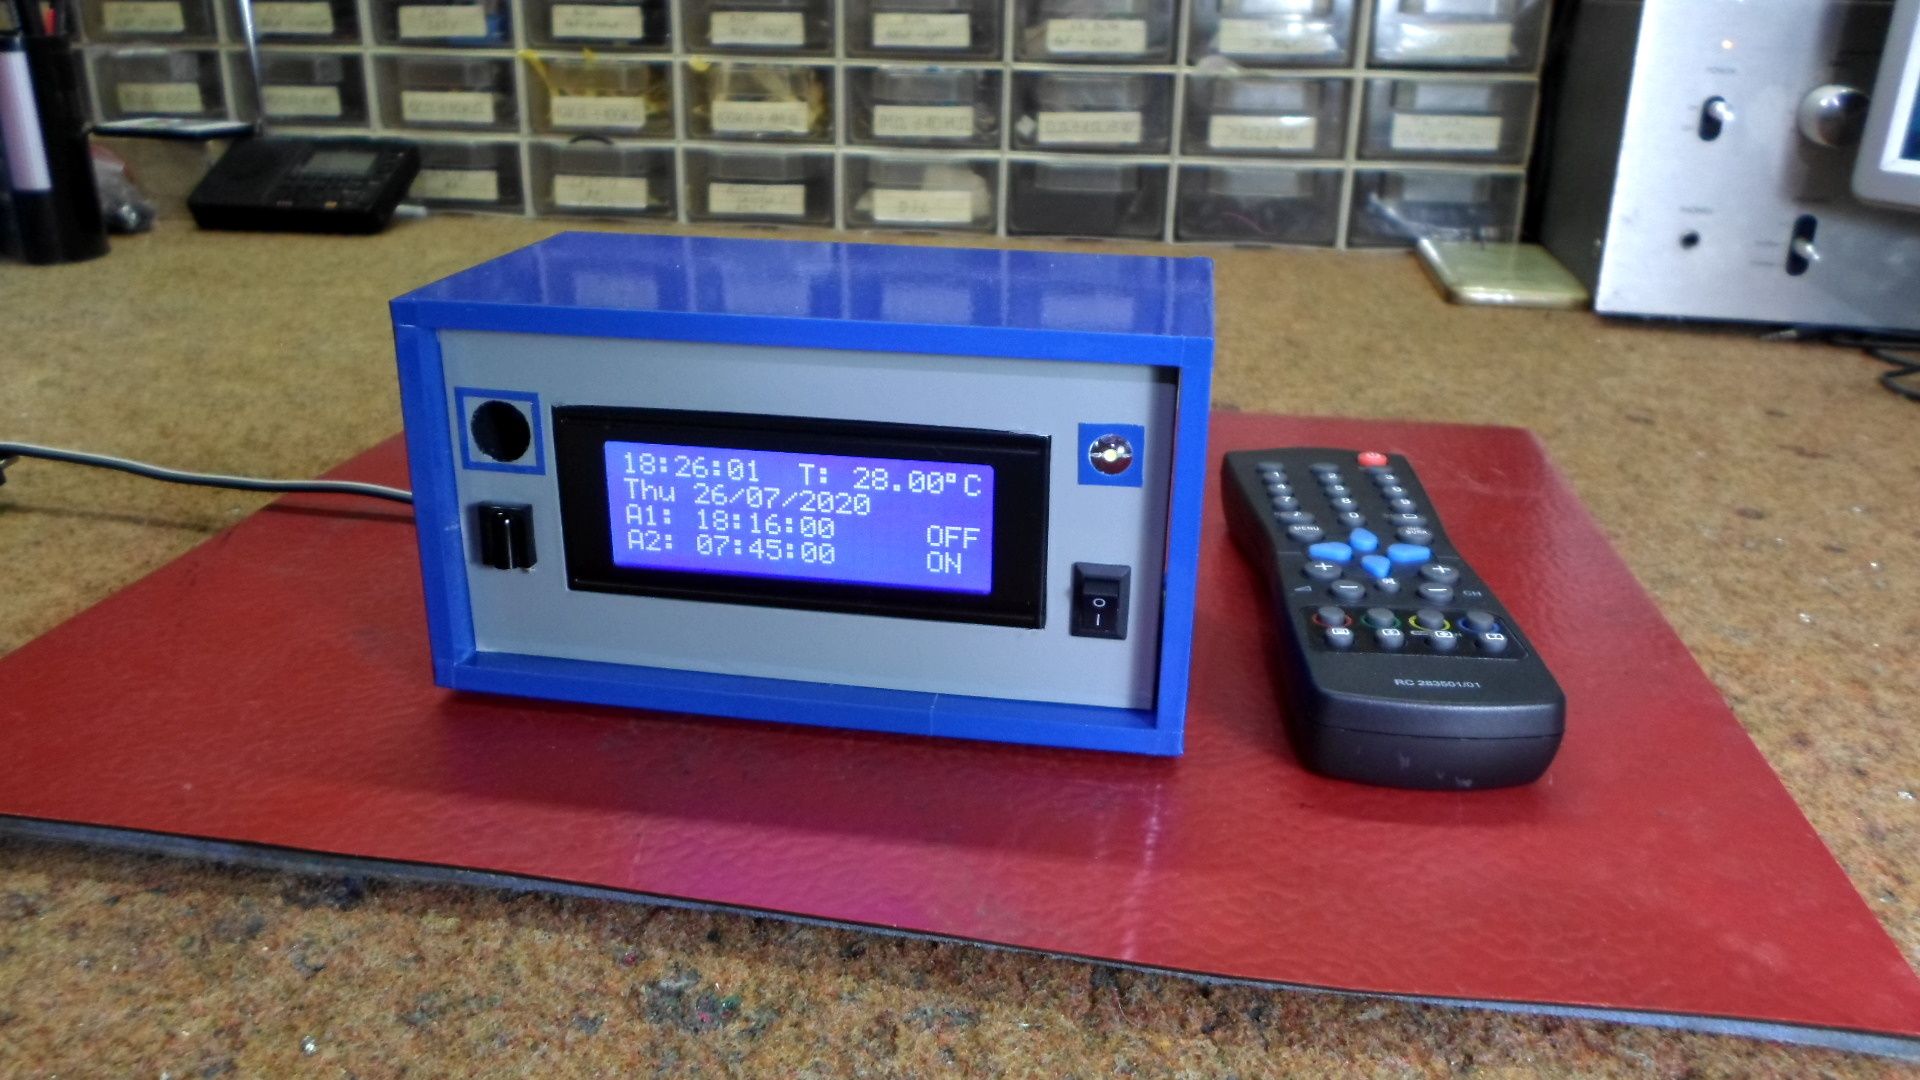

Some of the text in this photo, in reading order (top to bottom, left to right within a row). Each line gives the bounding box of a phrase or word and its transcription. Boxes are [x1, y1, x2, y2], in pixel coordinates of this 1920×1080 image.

[624, 452, 759, 482] 18:26:01
[799, 463, 827, 486] T:
[624, 477, 871, 515] Thu 26/07/2020
[626, 503, 981, 549] A1: 18:16:00 OFF
[627, 529, 962, 574] A2: 07:45:00 ON
[1393, 678, 1481, 689] RC 283501/01
